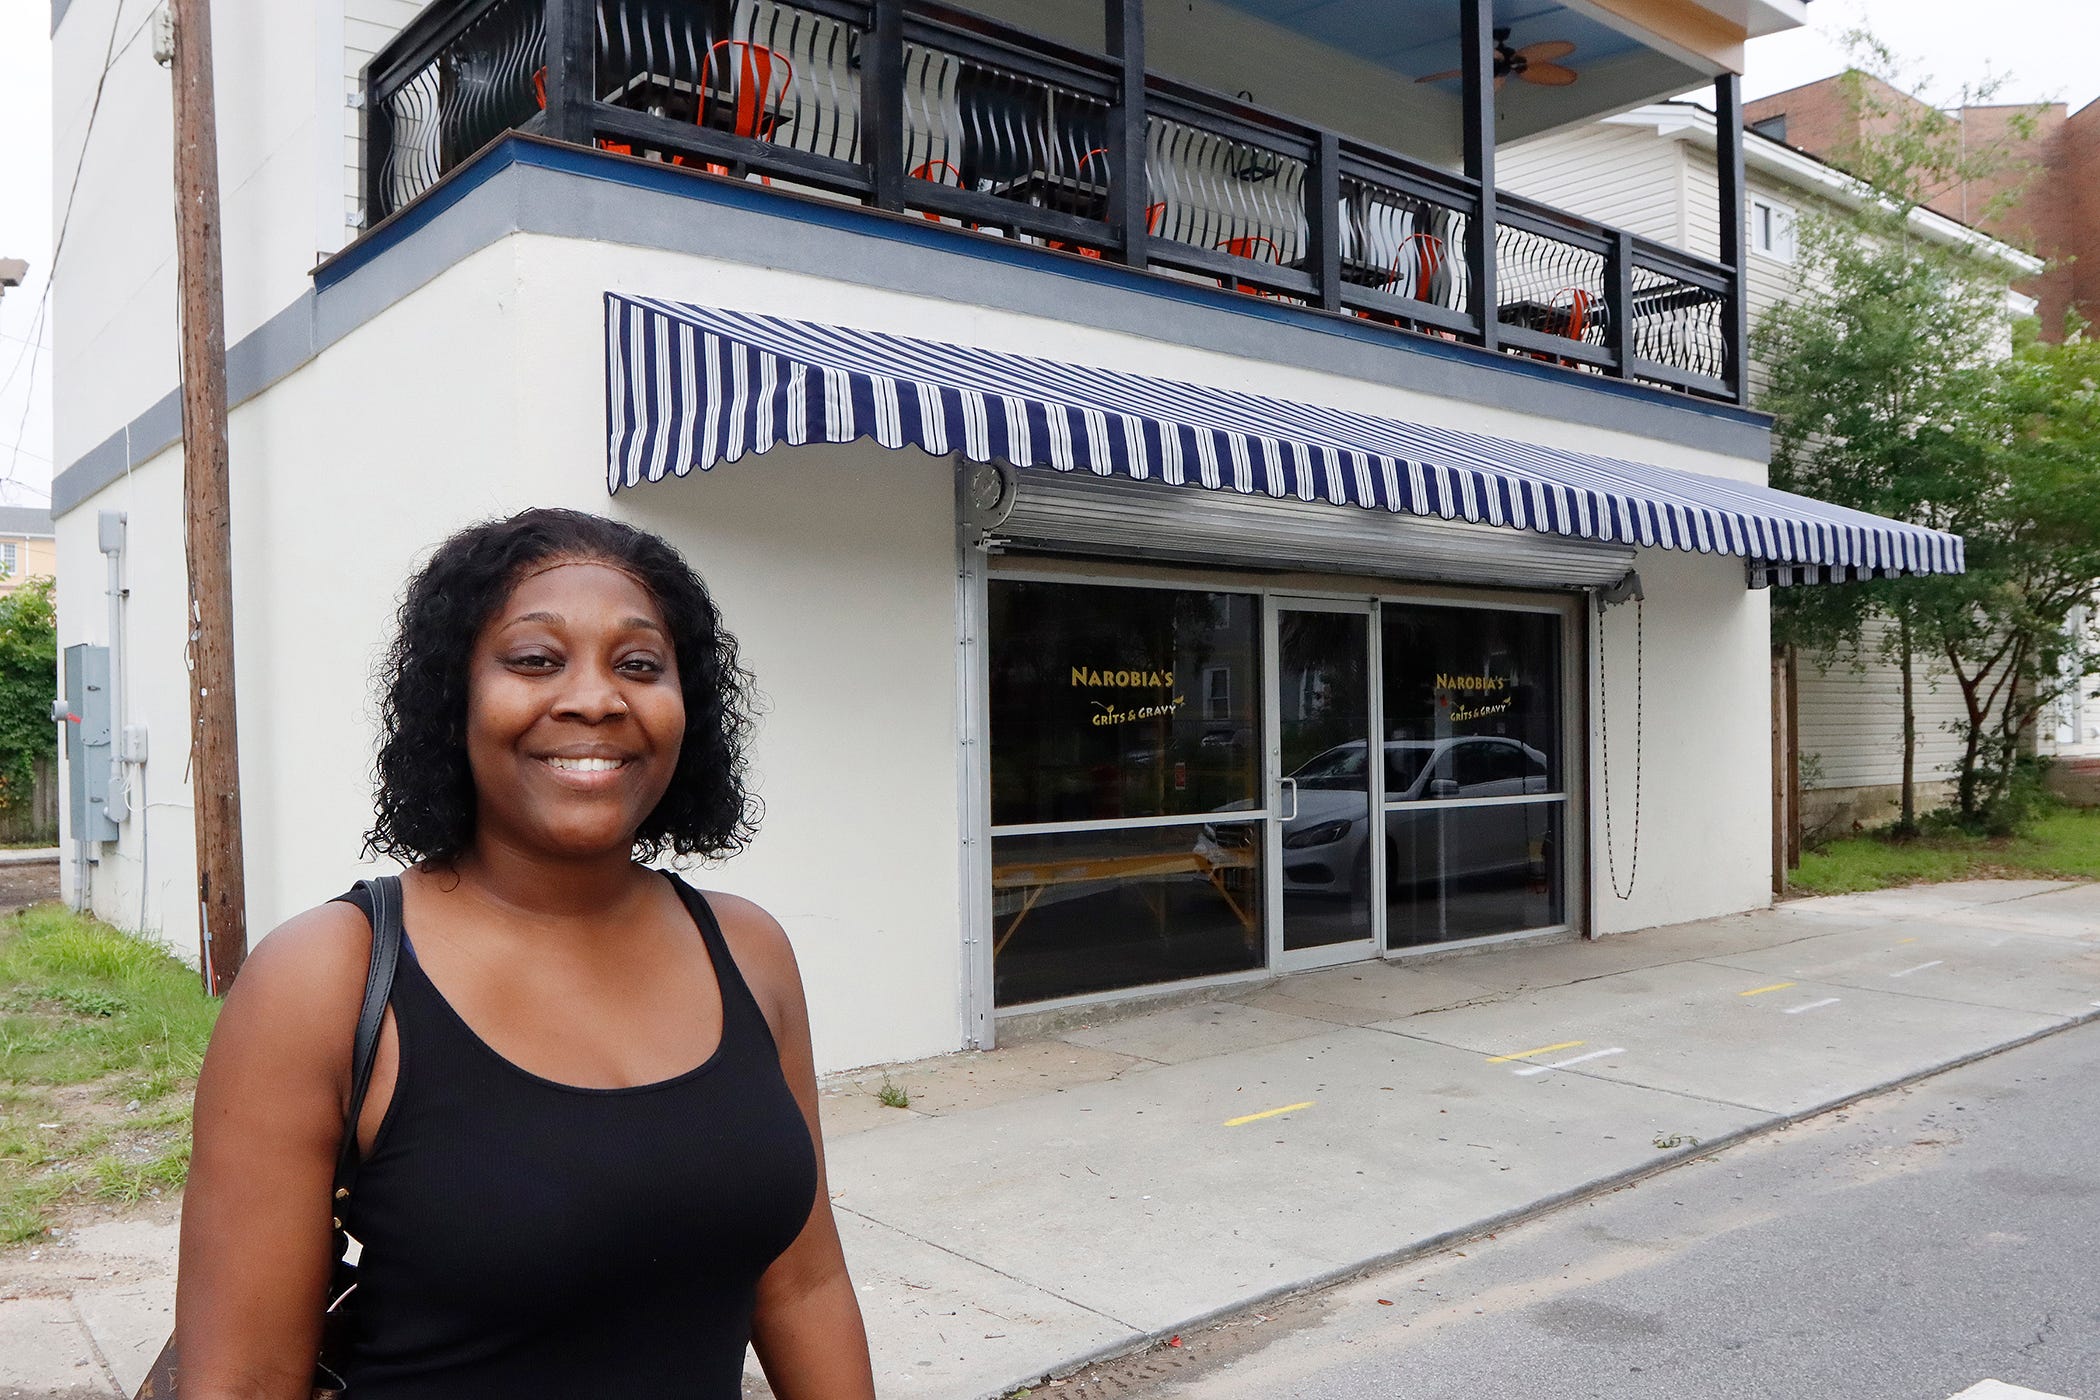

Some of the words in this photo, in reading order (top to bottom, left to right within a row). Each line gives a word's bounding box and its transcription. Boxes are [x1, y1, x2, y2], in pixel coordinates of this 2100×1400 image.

[1071, 666, 1174, 687] NAROBIA'S
[1436, 673, 1504, 690] NAROBIA'S
[1092, 710, 1126, 726] GRITS
[1127, 710, 1136, 721] &
[1138, 705, 1176, 719] GRAVY
[1450, 709, 1472, 721] GRITS
[1473, 708, 1480, 718] &
[1480, 704, 1506, 717] GRAVY
